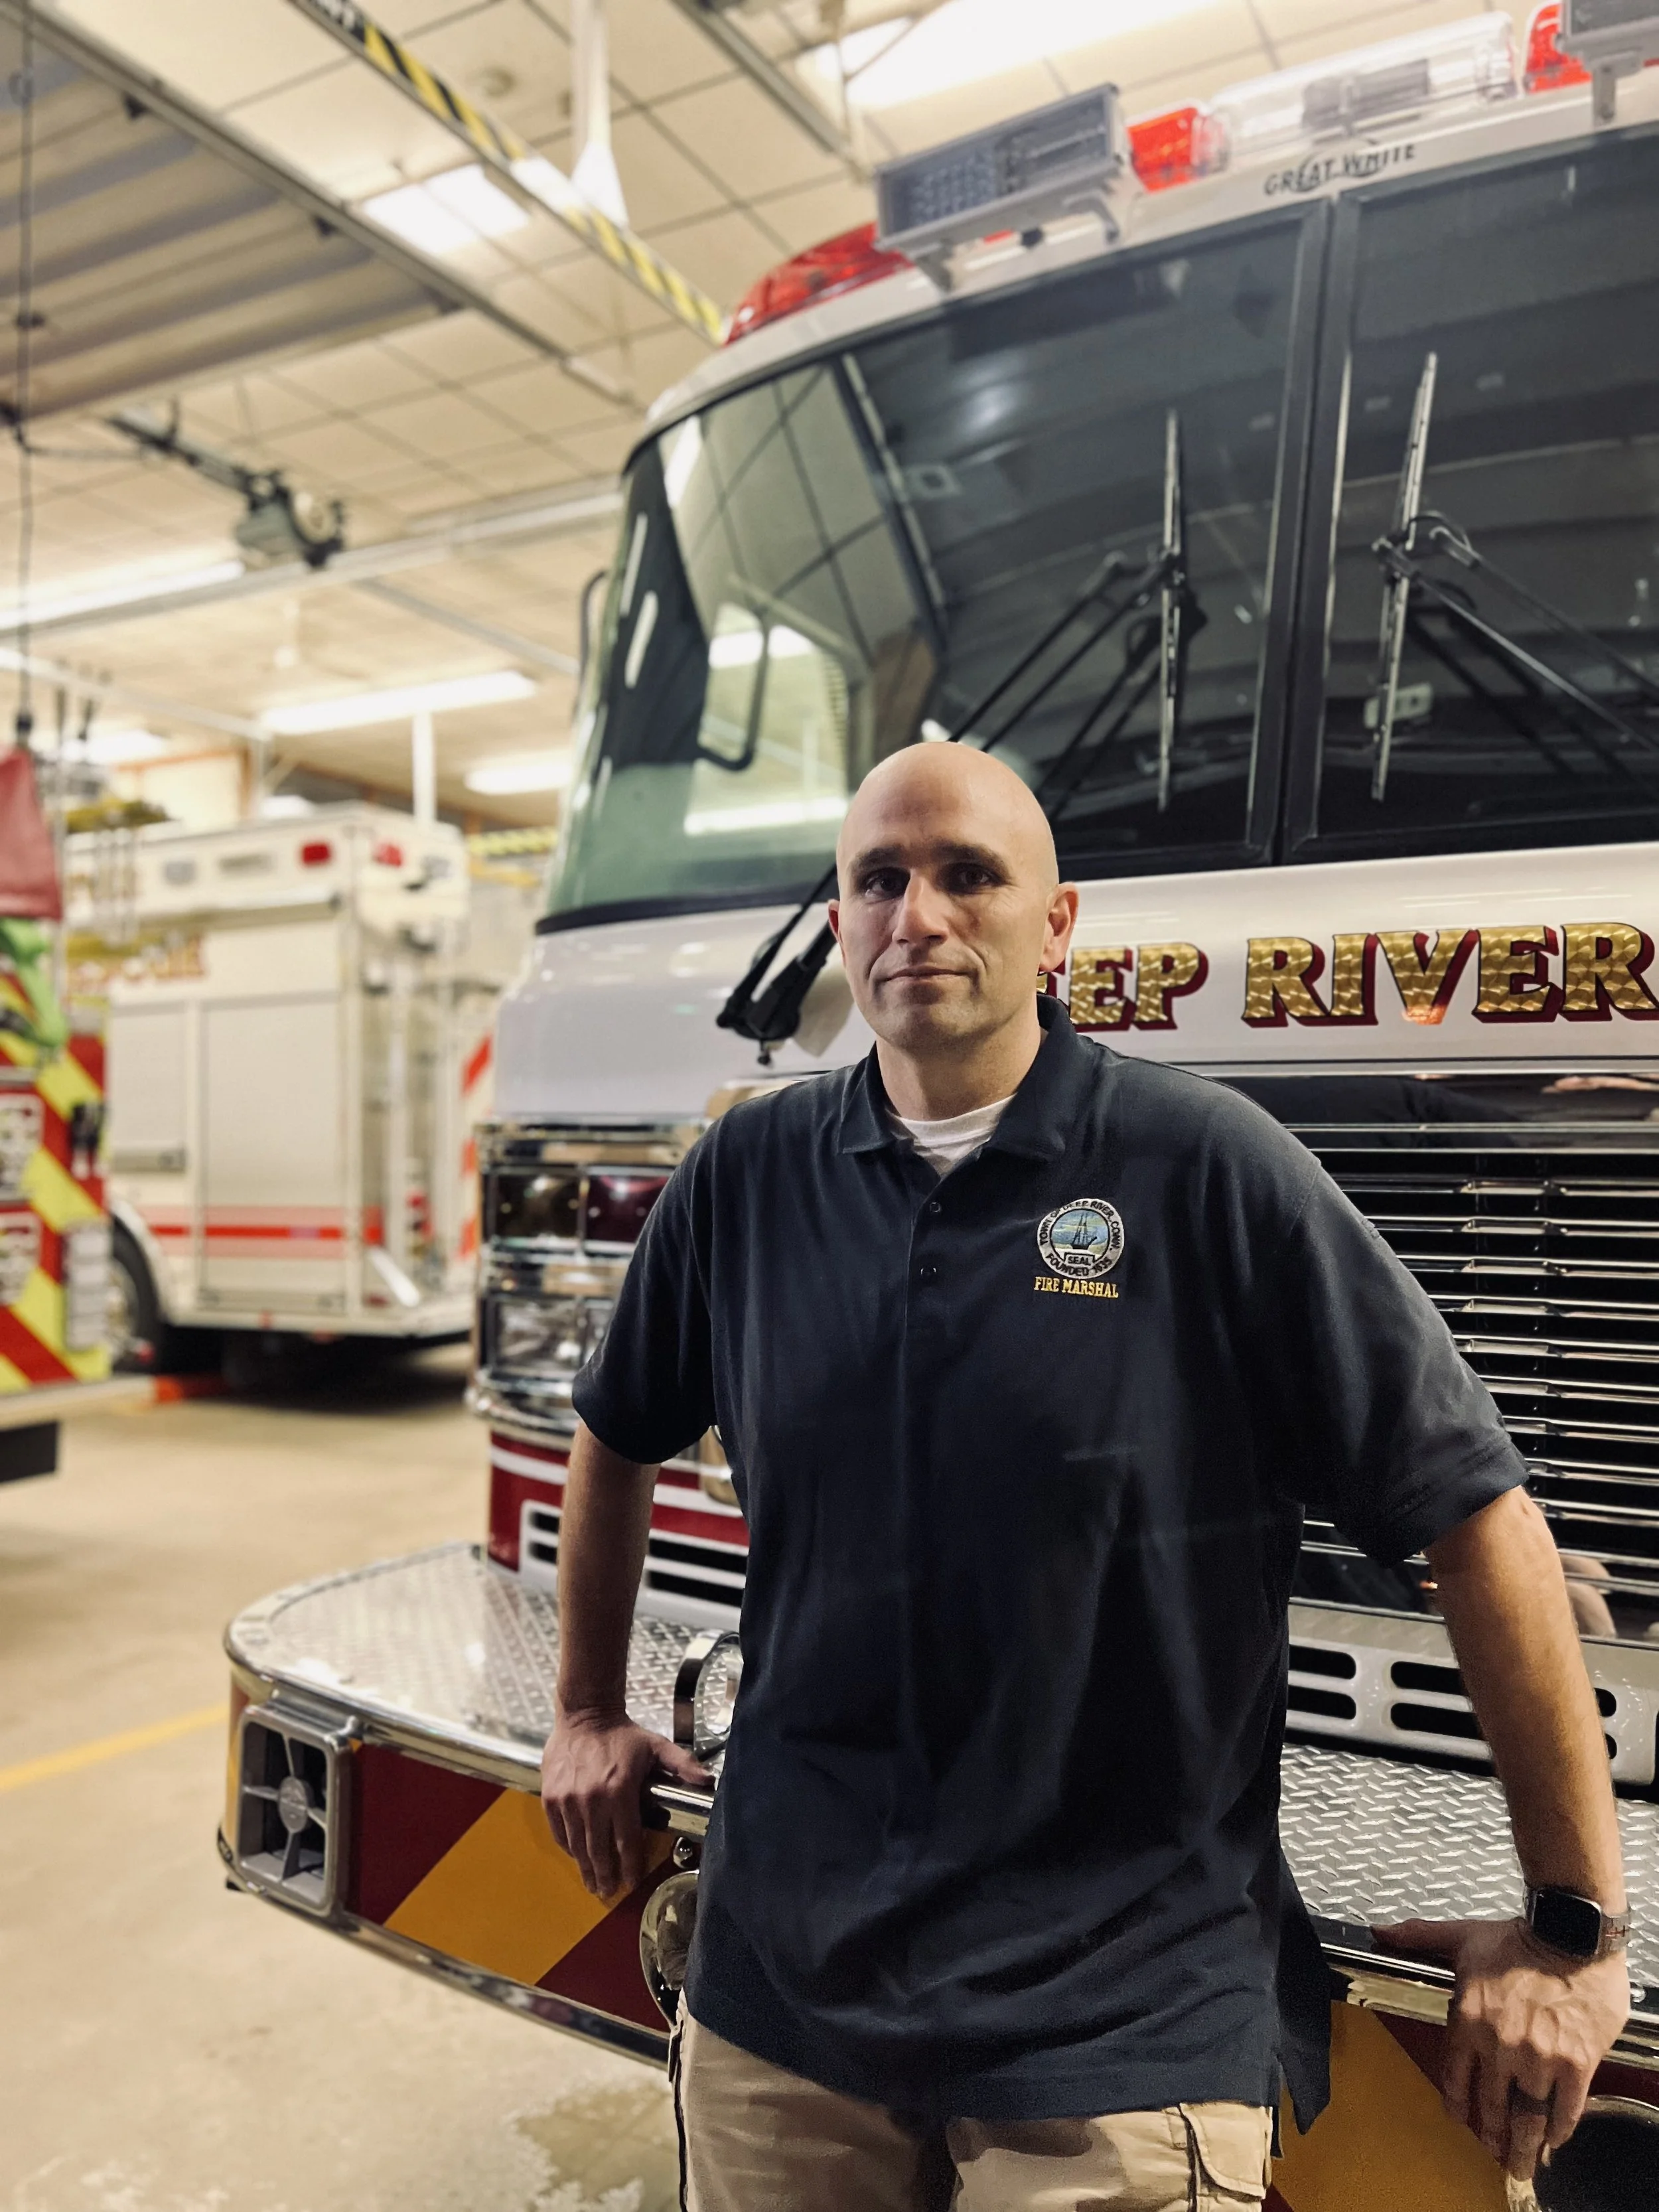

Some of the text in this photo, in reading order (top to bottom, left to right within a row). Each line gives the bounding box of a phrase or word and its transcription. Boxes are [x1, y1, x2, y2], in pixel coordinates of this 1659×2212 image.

[1263, 143, 1415, 195] GREAT WHITE
[1242, 922, 1659, 1028] RIVER
[1039, 1218, 1052, 1245] TOWN
[1062, 1200, 1089, 1211] DEEP
[1045, 1253, 1089, 1276] FOUNDED
[1068, 1255, 1092, 1266] SEAL
[1034, 1276, 1119, 1298] FIRE MARSHAL
